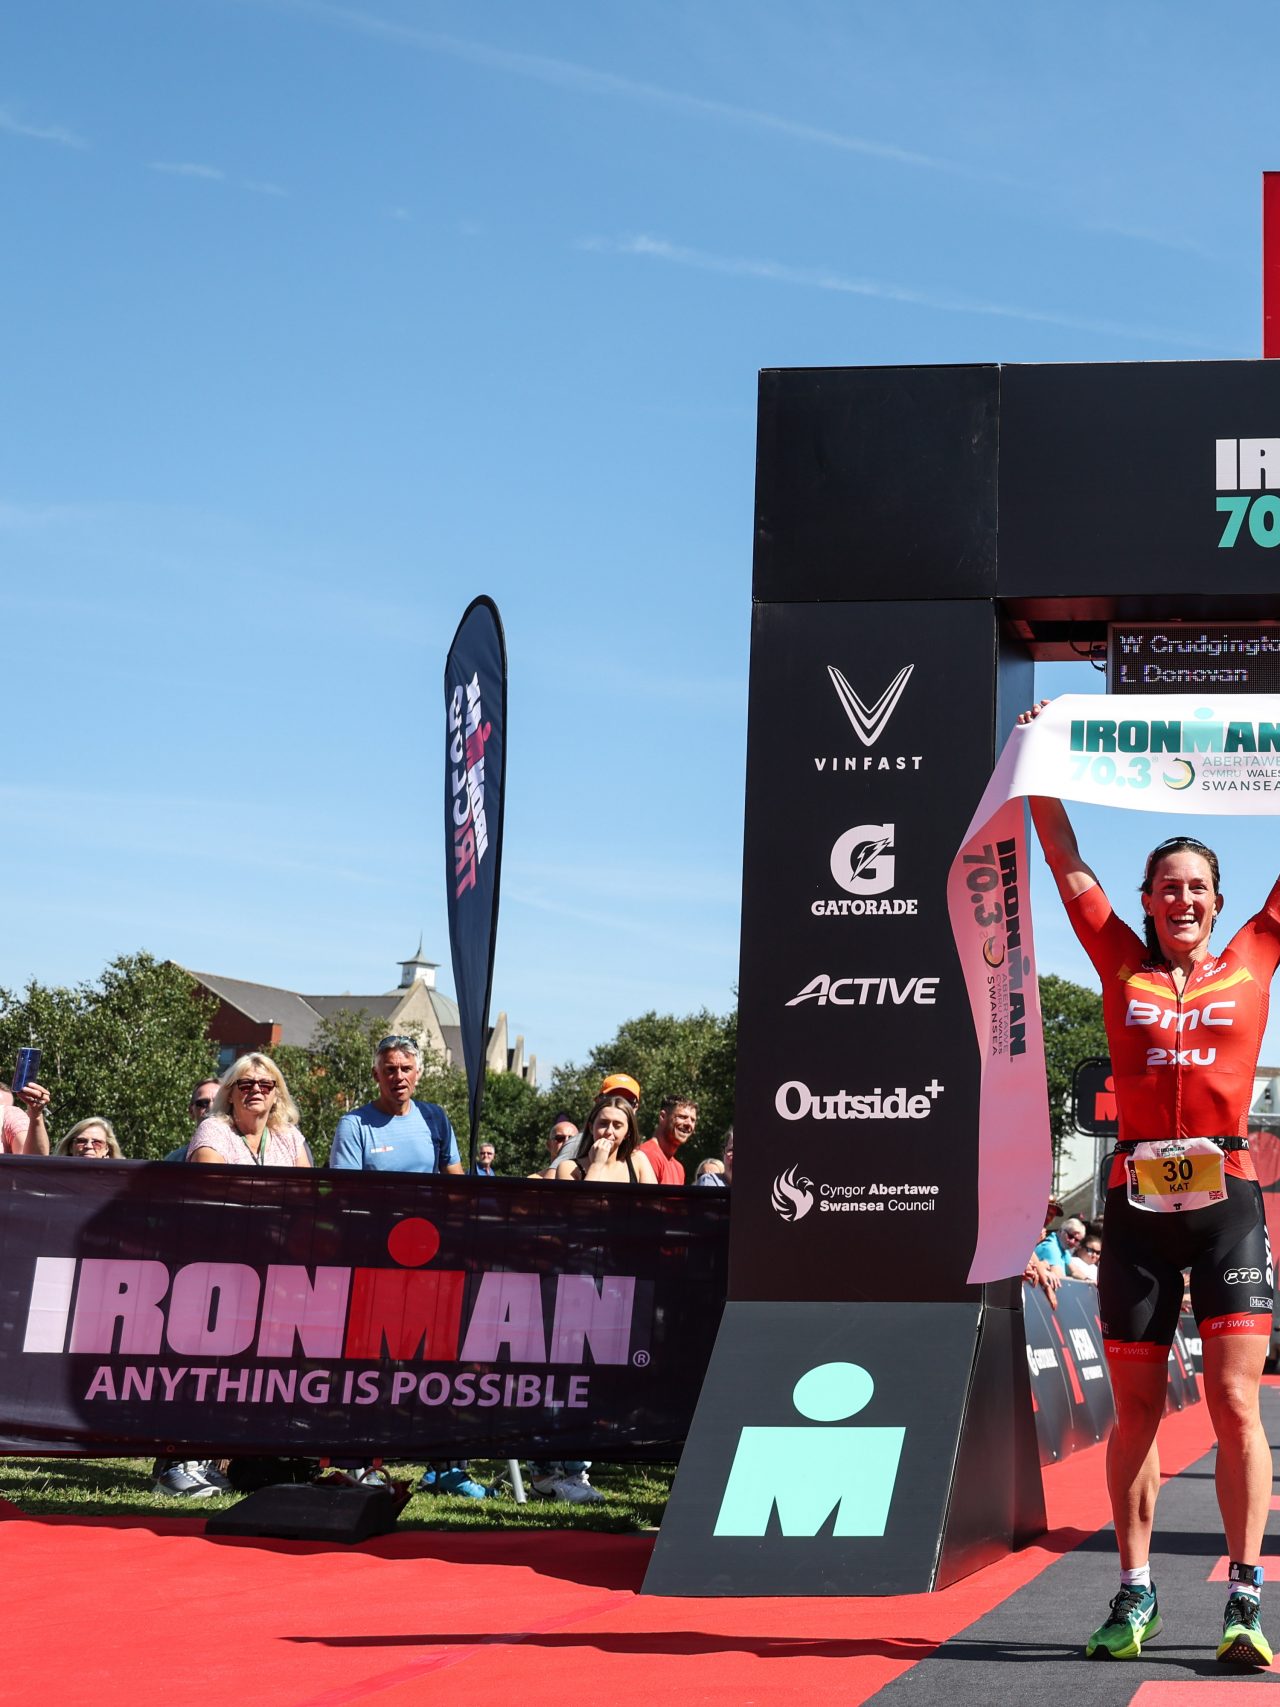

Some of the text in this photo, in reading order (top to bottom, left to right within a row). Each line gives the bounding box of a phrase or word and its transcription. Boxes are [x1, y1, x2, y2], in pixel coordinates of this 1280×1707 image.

[1119, 635, 1143, 653] W
[1119, 664, 1136, 683] L
[1143, 664, 1249, 683] Donovan
[814, 755, 923, 771] VINFAST
[1070, 755, 1152, 789] 70.3
[1201, 769, 1242, 779] CYMRU
[962, 844, 1004, 929] 70.3
[811, 899, 918, 916] GATORADE
[996, 837, 1030, 1057] IRONMAN
[784, 973, 941, 1007] ACTIVE
[986, 975, 998, 1056] SWANSEA
[1162, 1158, 1193, 1182] 30
[819, 1183, 939, 1198] Cyngor Abertawe
[1169, 1183, 1190, 1193] KAT
[819, 1199, 936, 1212] Swansea Council
[22, 1256, 637, 1365] IRONMAN
[1211, 1319, 1255, 1330] DT SWISS
[1123, 1347, 1149, 1356] SWISS
[85, 1365, 591, 1410] ANYTHING IS POSSIBLE
